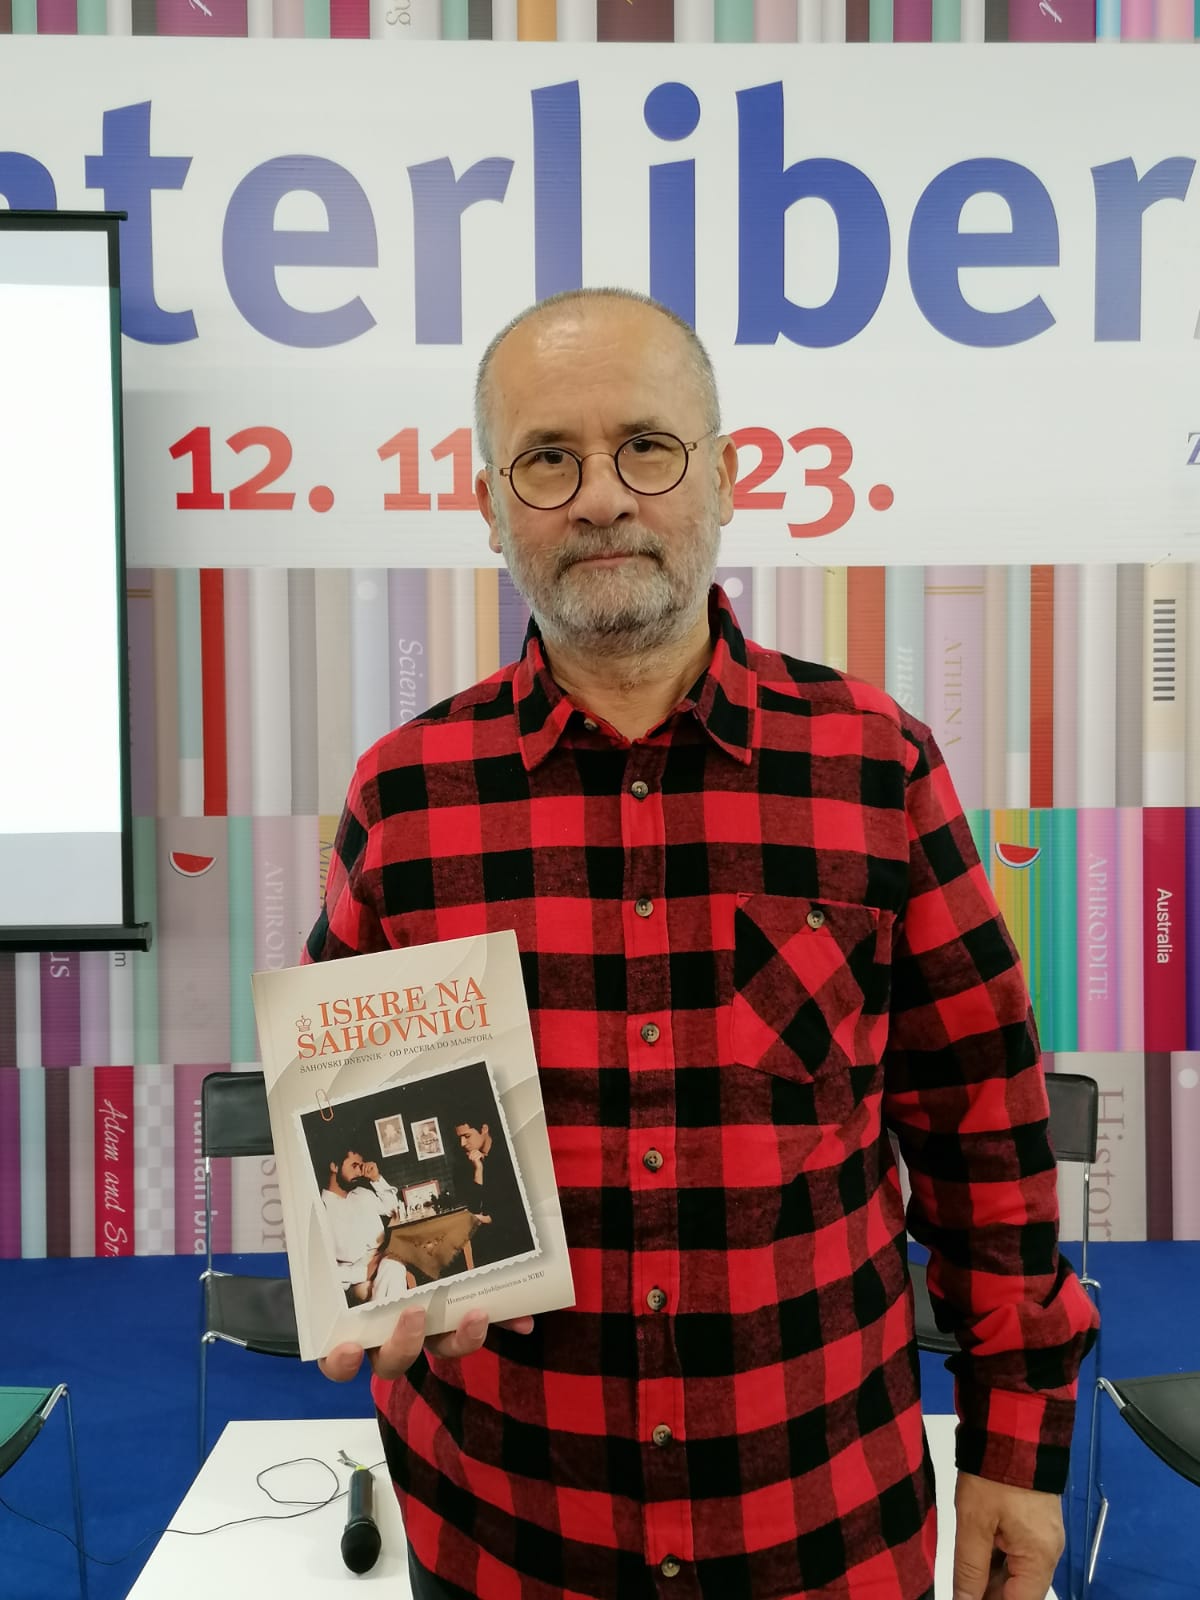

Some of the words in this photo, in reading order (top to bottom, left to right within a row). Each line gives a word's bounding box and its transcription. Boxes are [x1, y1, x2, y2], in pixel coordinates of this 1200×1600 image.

[169, 426, 334, 513] 12.
[1088, 853, 1108, 1001] APHRODITE
[1156, 887, 1173, 964] Australia
[317, 985, 427, 1028] ISKRE
[434, 976, 487, 1007] NA
[98, 1099, 128, 1162] Adam
[104, 1171, 126, 1213] and
[104, 1221, 128, 1257] So
